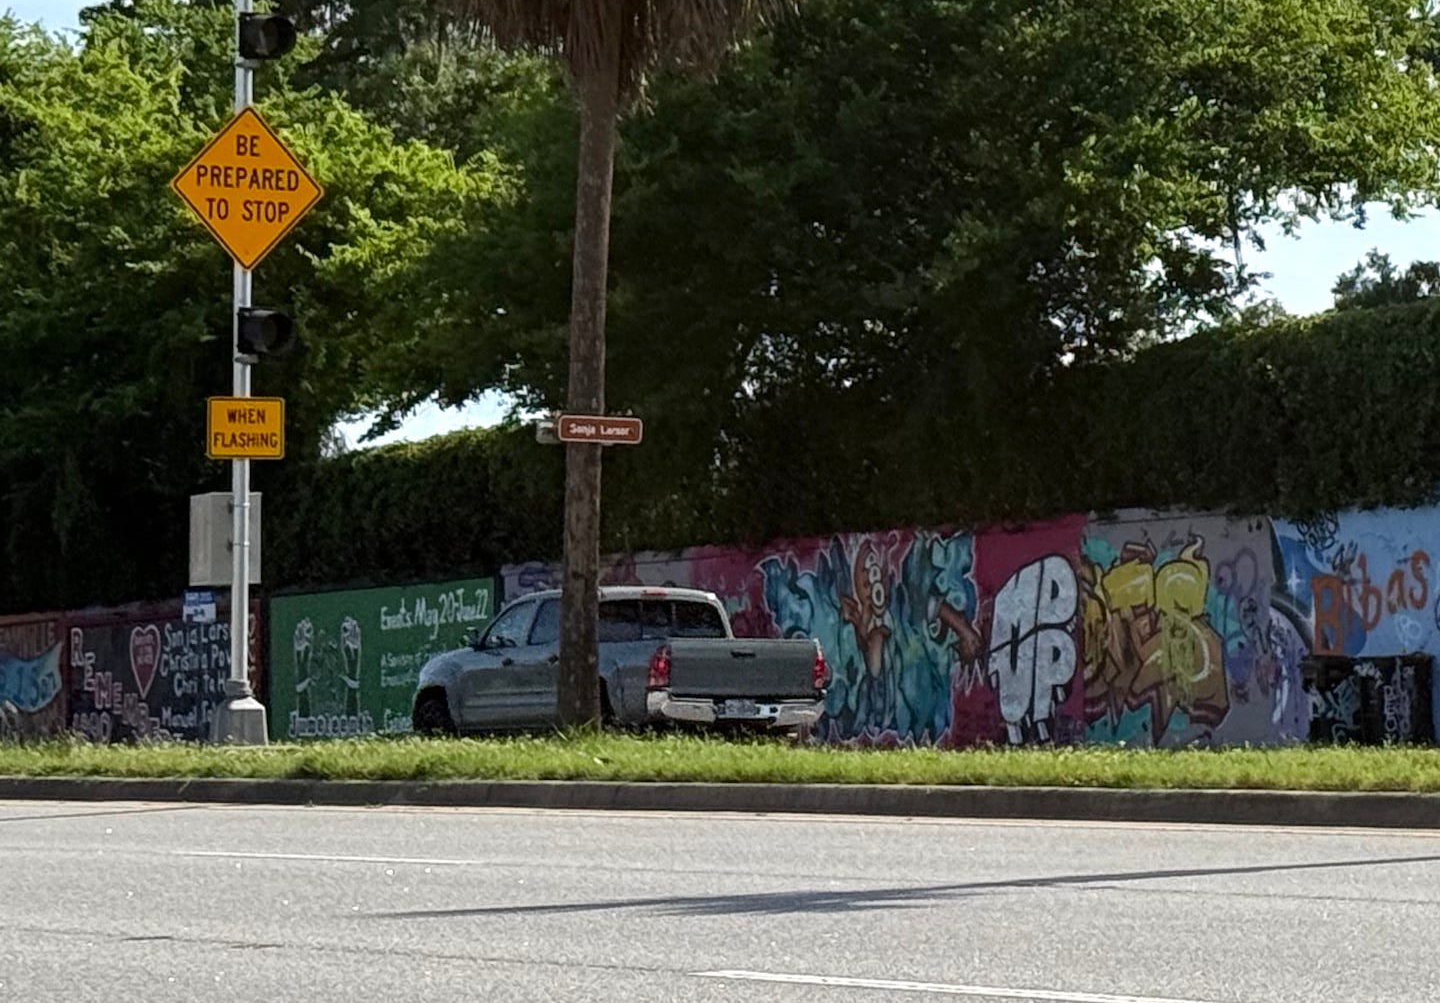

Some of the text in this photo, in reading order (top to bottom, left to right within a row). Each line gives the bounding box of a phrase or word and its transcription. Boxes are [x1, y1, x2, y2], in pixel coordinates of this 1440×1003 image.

[235, 134, 260, 157] BE
[196, 165, 299, 192] PREPARED
[206, 197, 290, 223] TO STOP
[227, 408, 266, 424] WHEN
[569, 423, 596, 436] Sonja
[213, 432, 279, 449] FLASHING
